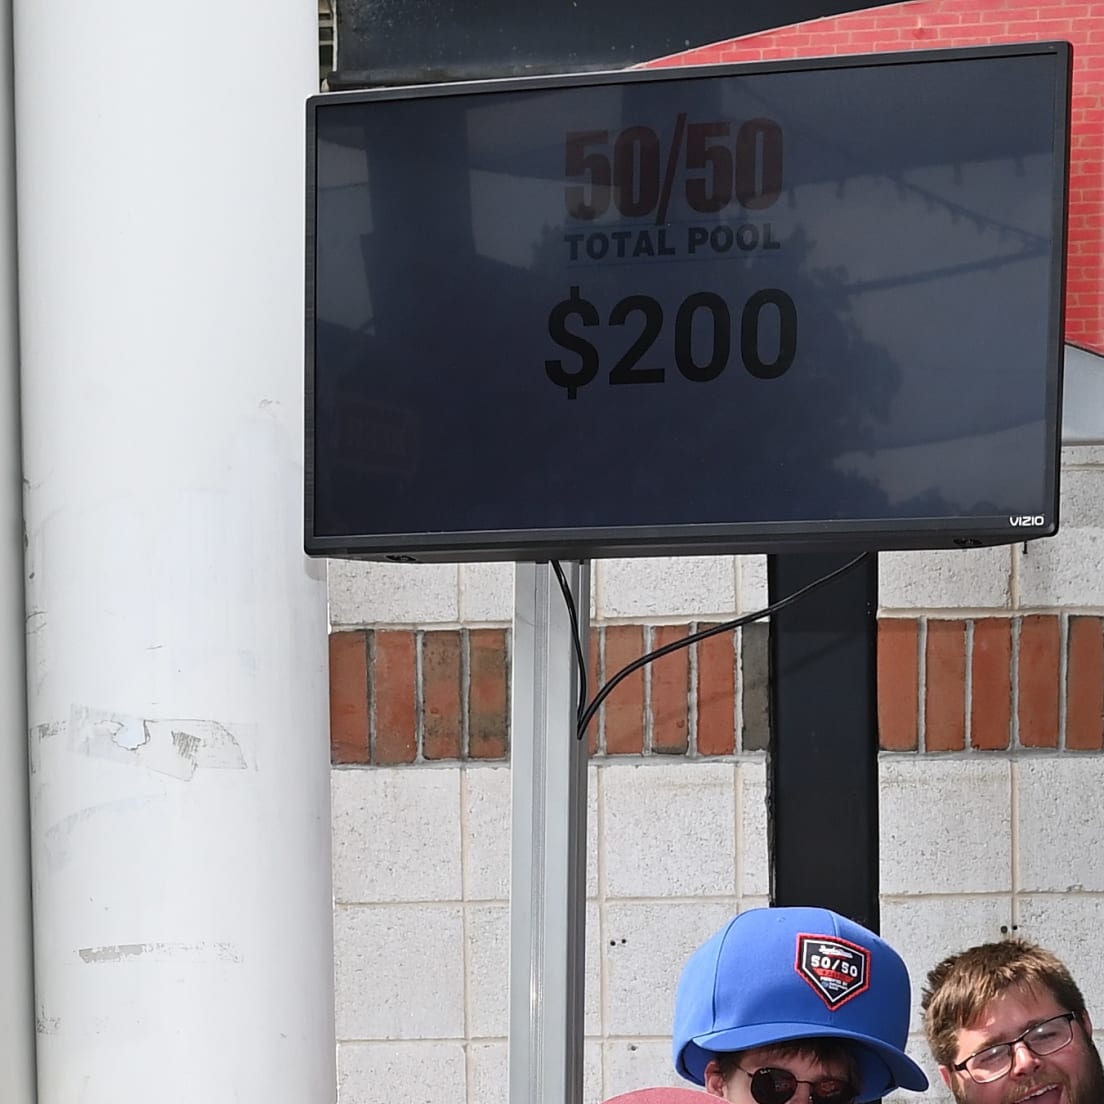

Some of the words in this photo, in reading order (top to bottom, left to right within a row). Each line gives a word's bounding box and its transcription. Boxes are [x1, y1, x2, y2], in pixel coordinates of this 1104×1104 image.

[564, 113, 784, 226] 50/50
[564, 228, 676, 262] TOTAL
[687, 223, 782, 254] POOL
[544, 286, 798, 400] $200
[1009, 514, 1045, 527] VIZIO
[811, 954, 858, 977] 50/50
